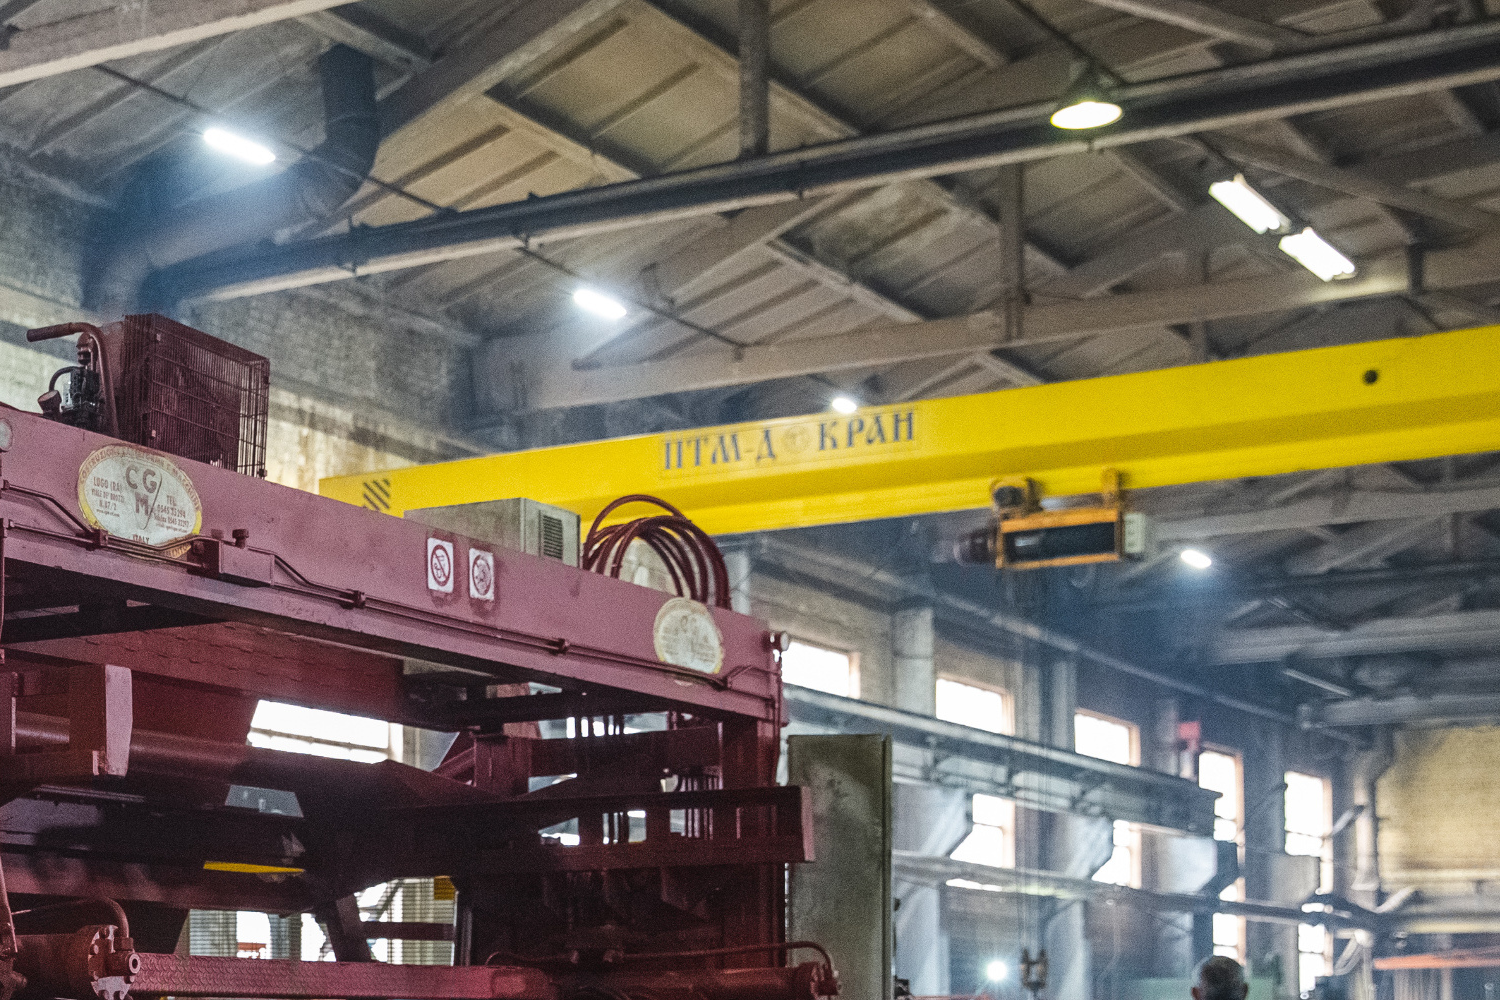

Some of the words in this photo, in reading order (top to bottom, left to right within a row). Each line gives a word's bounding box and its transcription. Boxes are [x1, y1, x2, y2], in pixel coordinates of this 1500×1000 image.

[817, 412, 915, 451] КРАН
[93, 476, 109, 489] LUGO
[125, 464, 158, 494] CG
[134, 491, 150, 517] M
